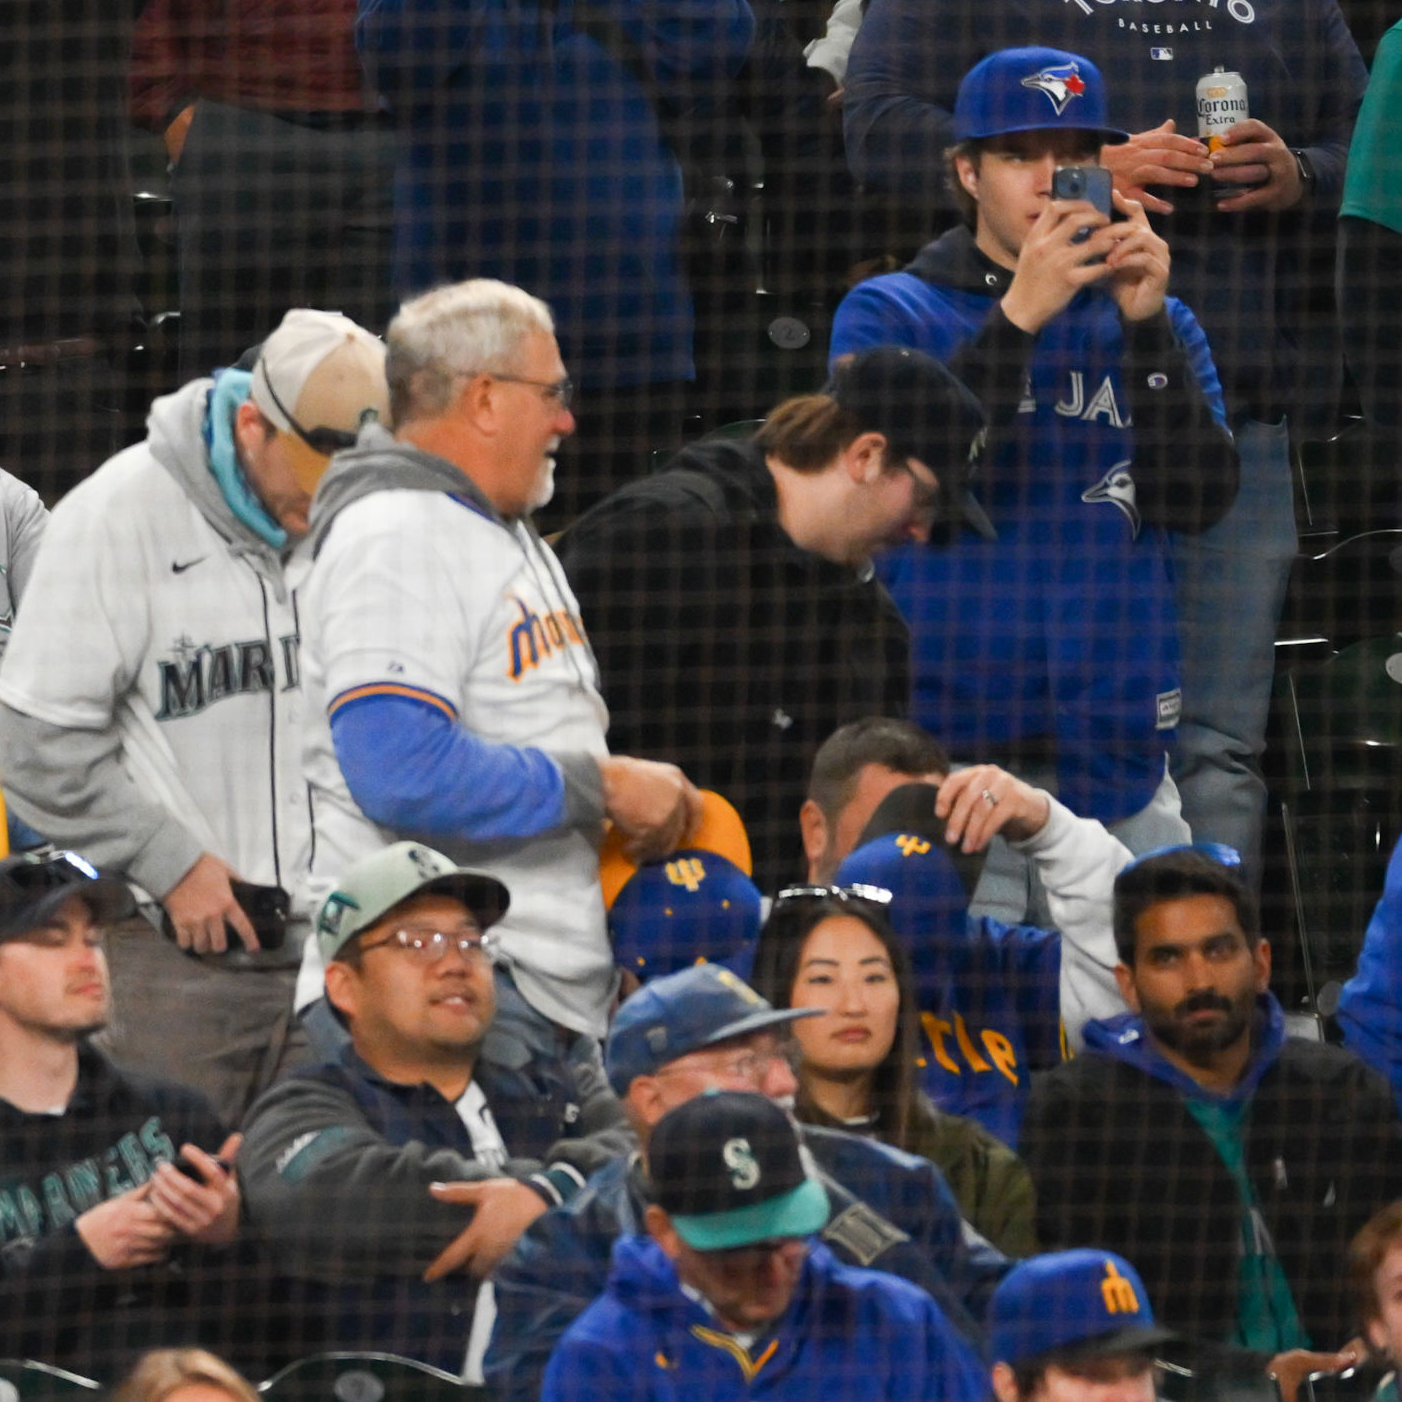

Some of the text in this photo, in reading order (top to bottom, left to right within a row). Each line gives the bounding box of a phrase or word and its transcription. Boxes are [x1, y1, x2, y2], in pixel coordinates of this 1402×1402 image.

[1118, 18, 1213, 34] BASEBALL
[1197, 97, 1248, 117] Corona
[1205, 114, 1237, 125] Extra
[1054, 370, 1134, 429] JA
